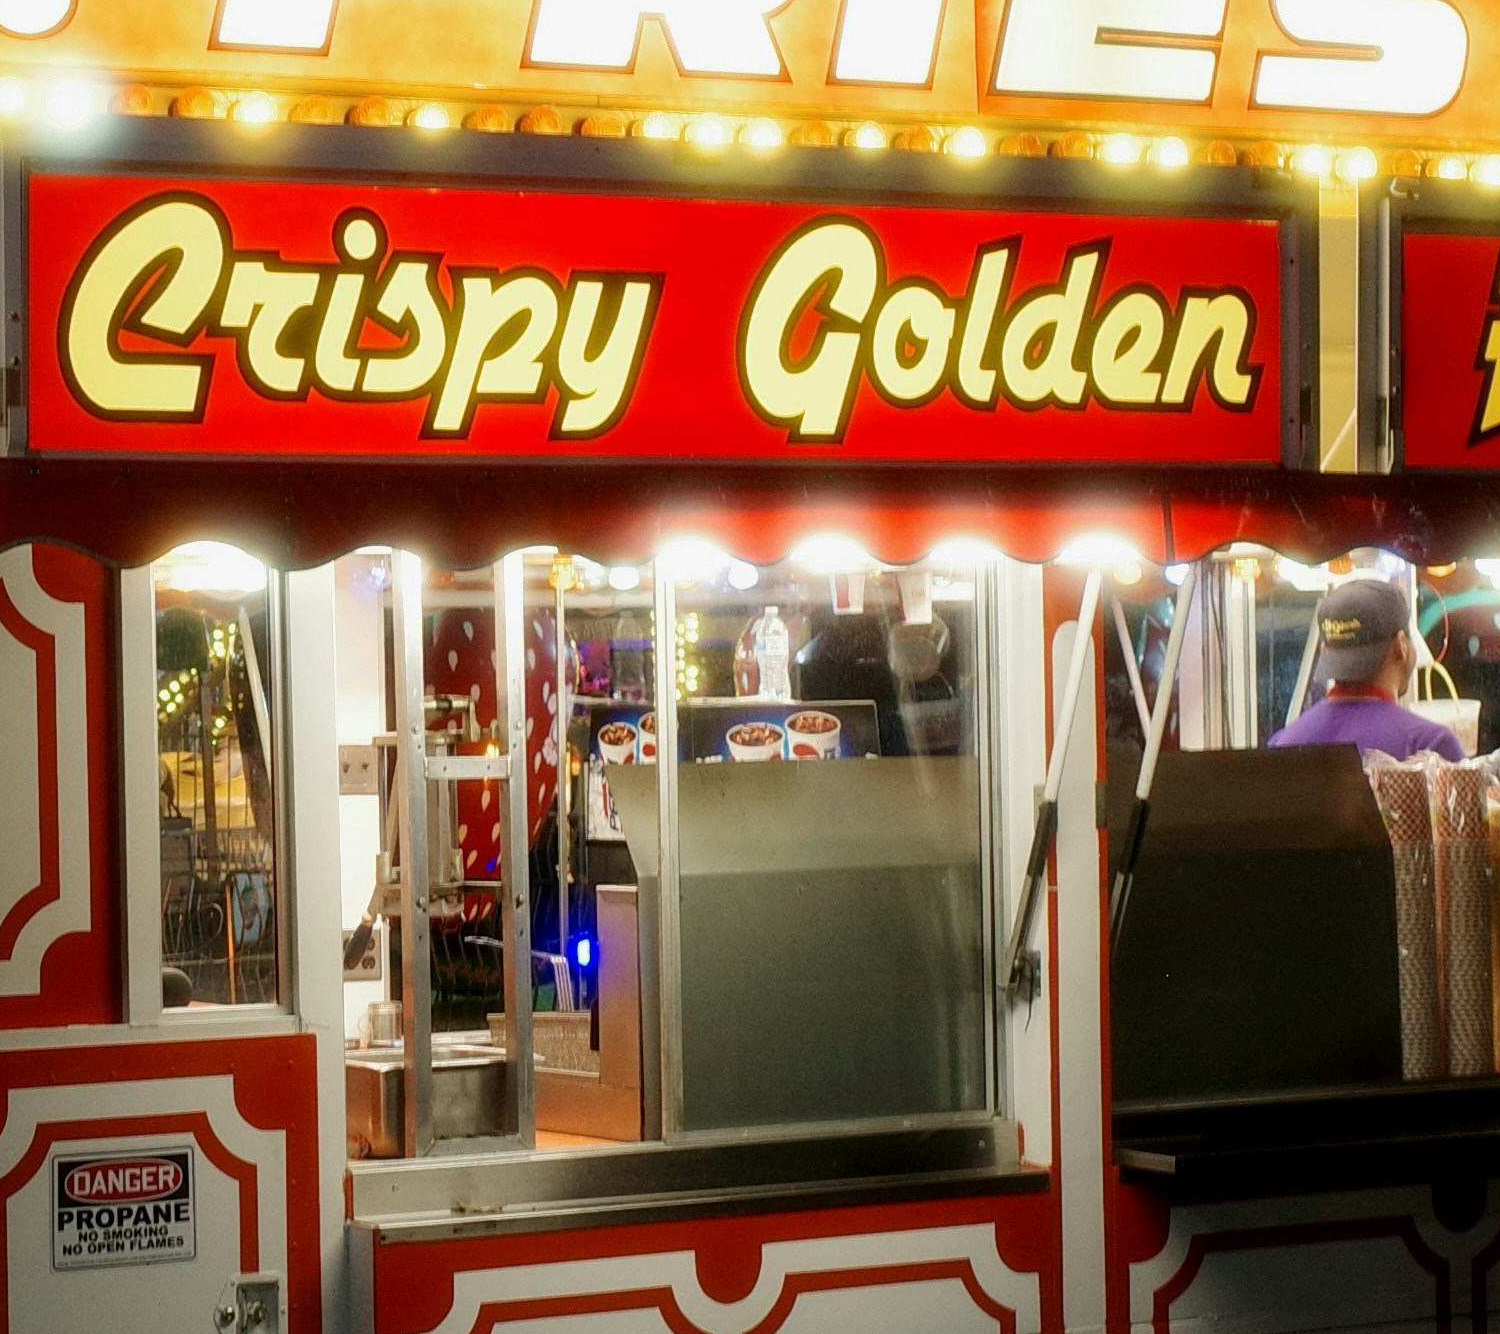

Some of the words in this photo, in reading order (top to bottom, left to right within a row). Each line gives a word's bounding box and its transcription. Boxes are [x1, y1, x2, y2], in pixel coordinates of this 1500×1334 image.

[60, 191, 666, 440] Crispy
[738, 214, 1263, 444] Golden
[72, 1165, 176, 1196] DANGER
[58, 1203, 190, 1230] PROPANE
[63, 1244, 82, 1256] NO
[88, 1241, 124, 1254] OPEN
[130, 1236, 184, 1251] FLAMES
[78, 1230, 98, 1242] NO
[103, 1225, 168, 1240] SMOKING
